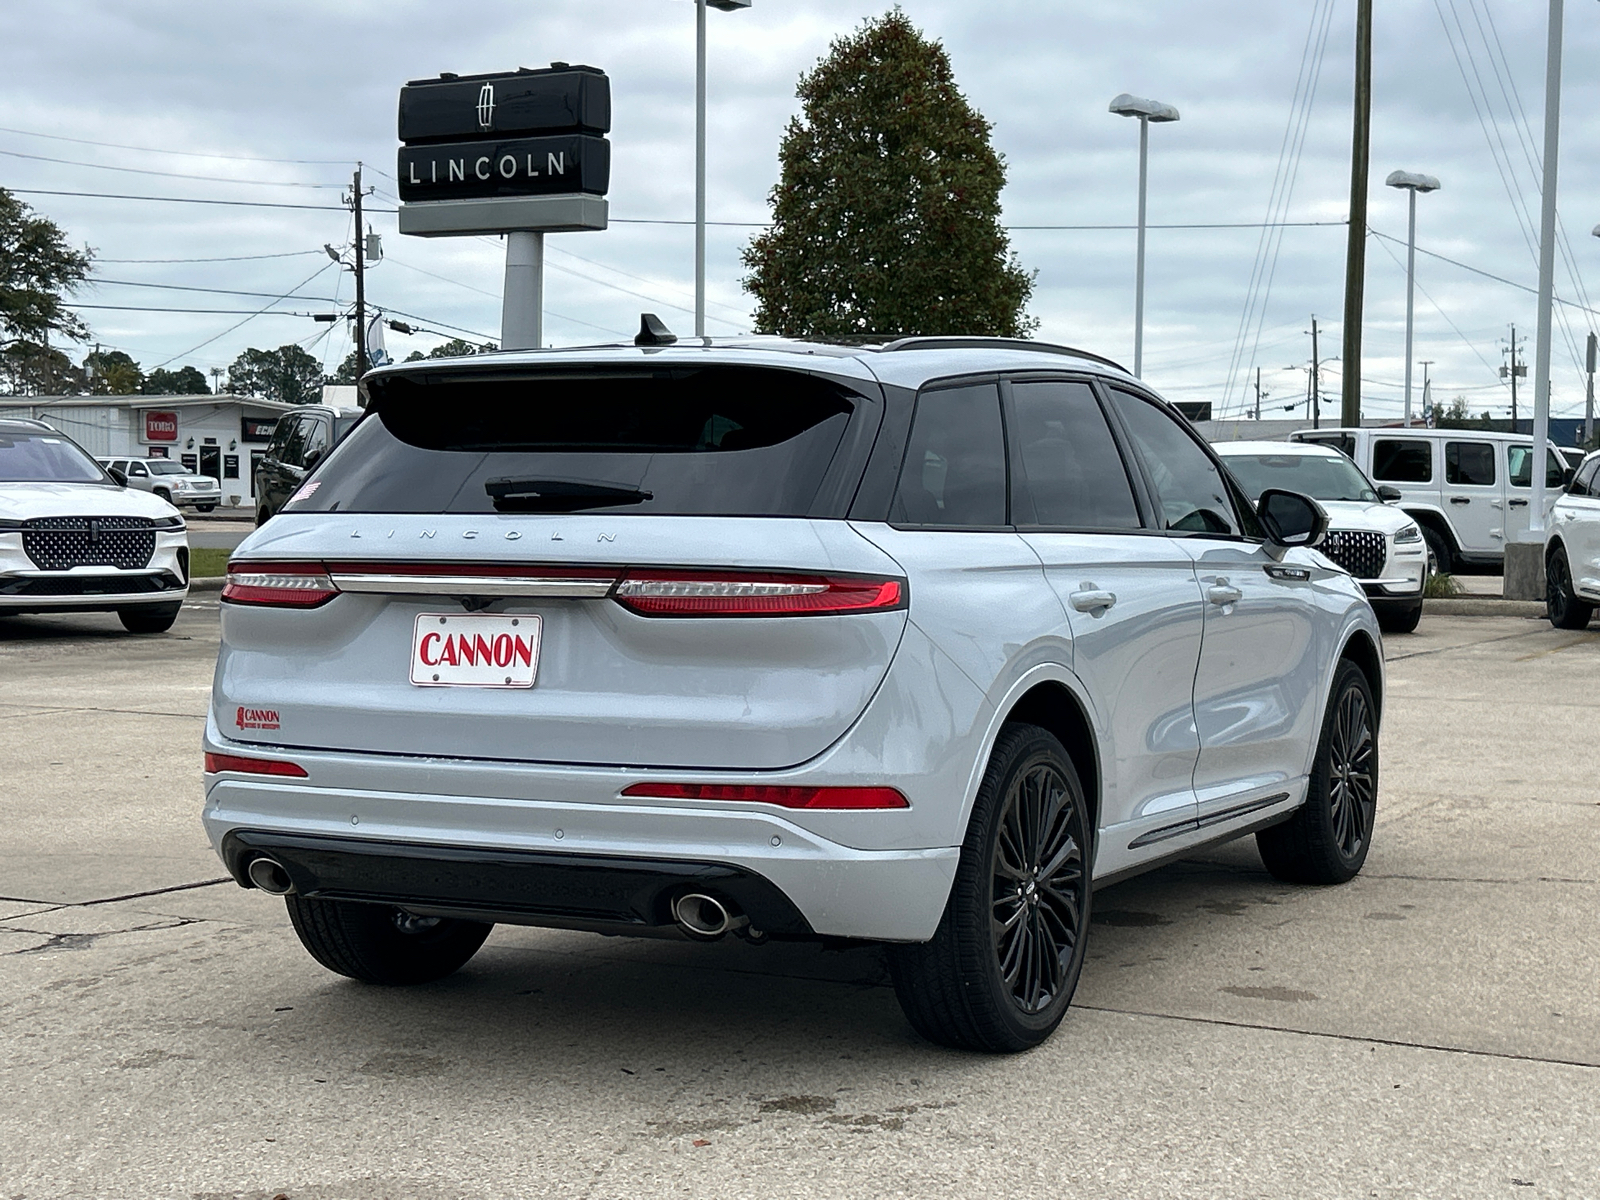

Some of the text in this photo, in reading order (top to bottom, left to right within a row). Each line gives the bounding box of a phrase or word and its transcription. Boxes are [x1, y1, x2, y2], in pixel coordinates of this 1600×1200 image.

[410, 151, 565, 184] LINCOLN
[149, 421, 175, 432] TORO
[350, 529, 617, 543] LINCOLN
[419, 632, 534, 668] CANNON
[244, 708, 280, 722] CANNON
